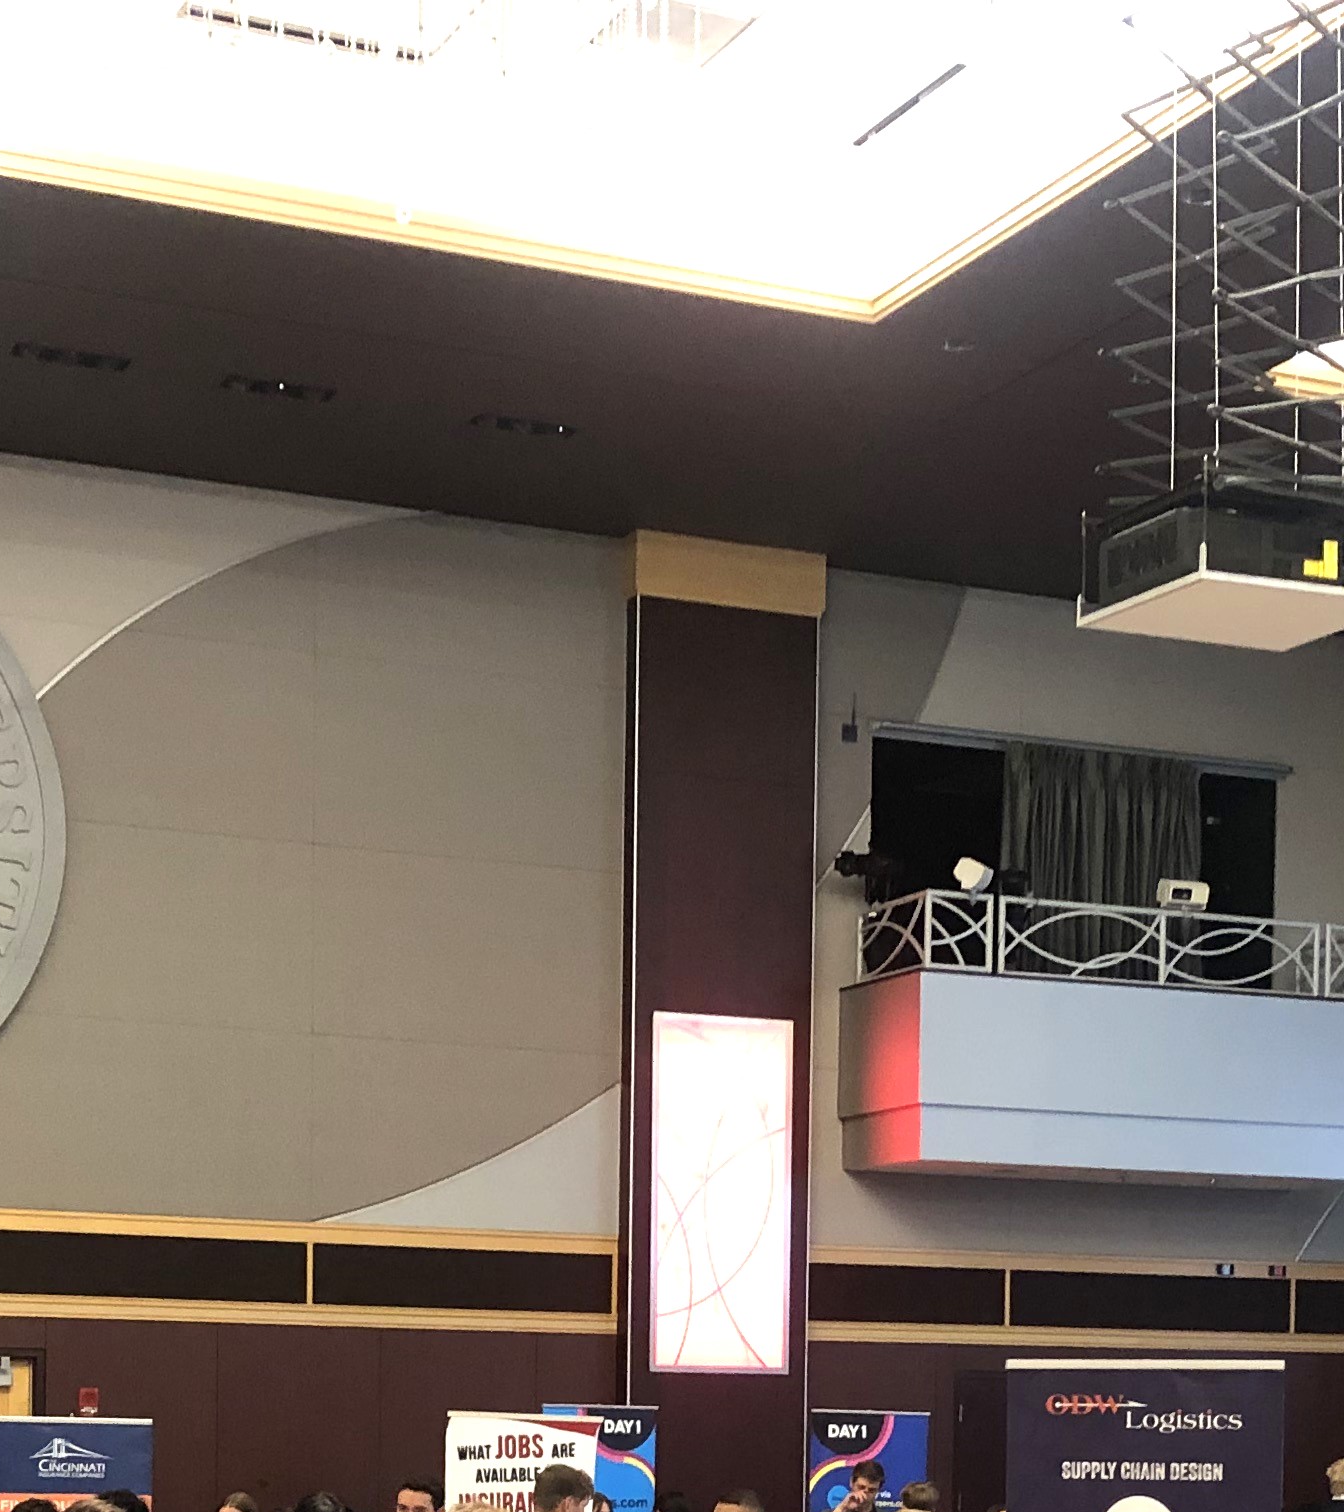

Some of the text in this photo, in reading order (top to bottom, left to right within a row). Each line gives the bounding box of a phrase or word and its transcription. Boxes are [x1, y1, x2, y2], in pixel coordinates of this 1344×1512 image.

[603, 1418, 642, 1434] DAY 1
[1124, 1408, 1244, 1434] Logistics
[827, 1423, 867, 1439] DAY 1
[457, 1433, 576, 1461] WHAT JOBS ARE
[38, 1459, 106, 1473] CINCINNATI
[1061, 1461, 1224, 1482] SUPPLY CHAIN DESIGN
